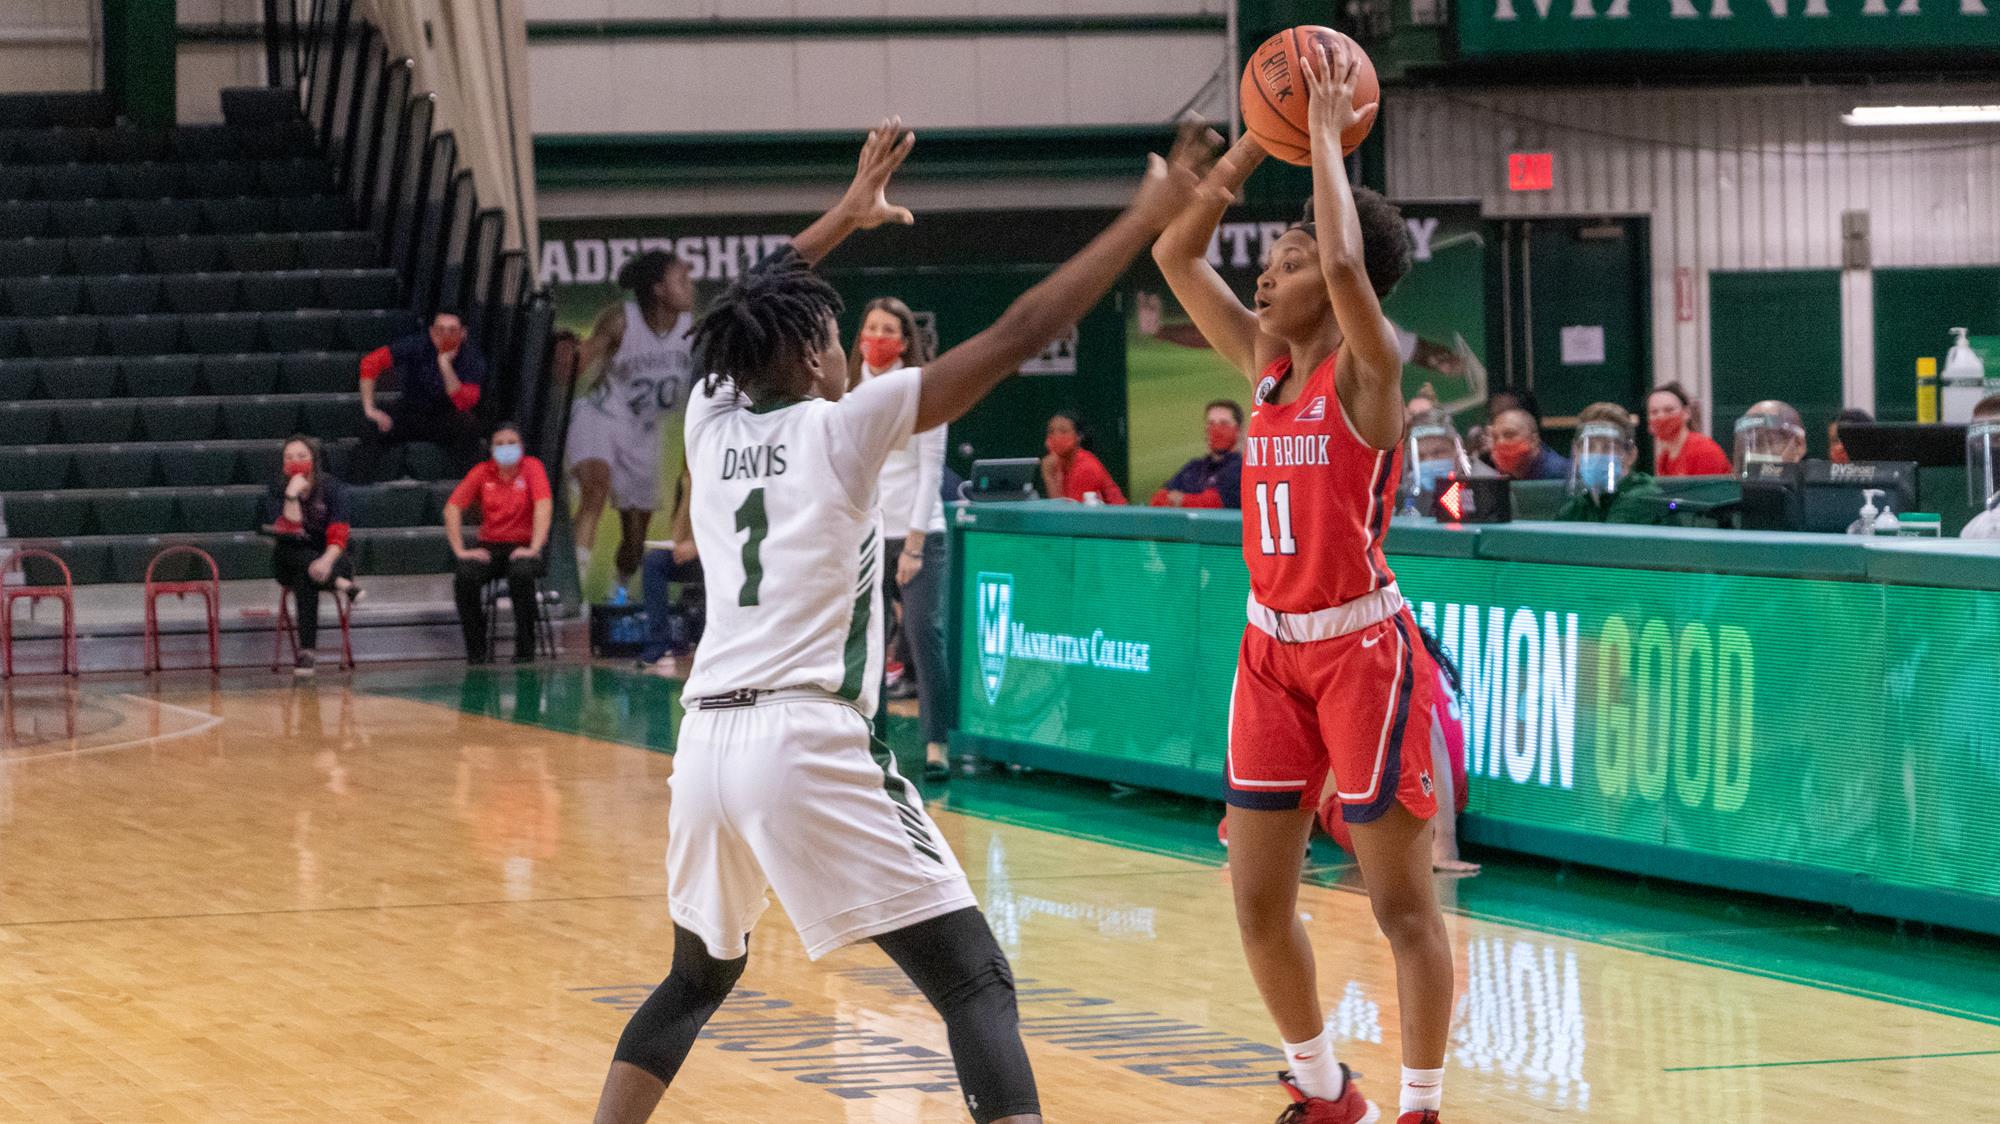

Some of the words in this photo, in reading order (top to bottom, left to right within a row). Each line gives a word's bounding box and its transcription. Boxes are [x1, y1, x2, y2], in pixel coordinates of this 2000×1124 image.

[1261, 50, 1294, 103] ROCK
[721, 444, 787, 480] DAVIS
[1272, 434, 1331, 466] BROOK
[735, 487, 768, 607] 1
[1256, 481, 1297, 555] 11
[1595, 613, 1754, 812] GOOD
